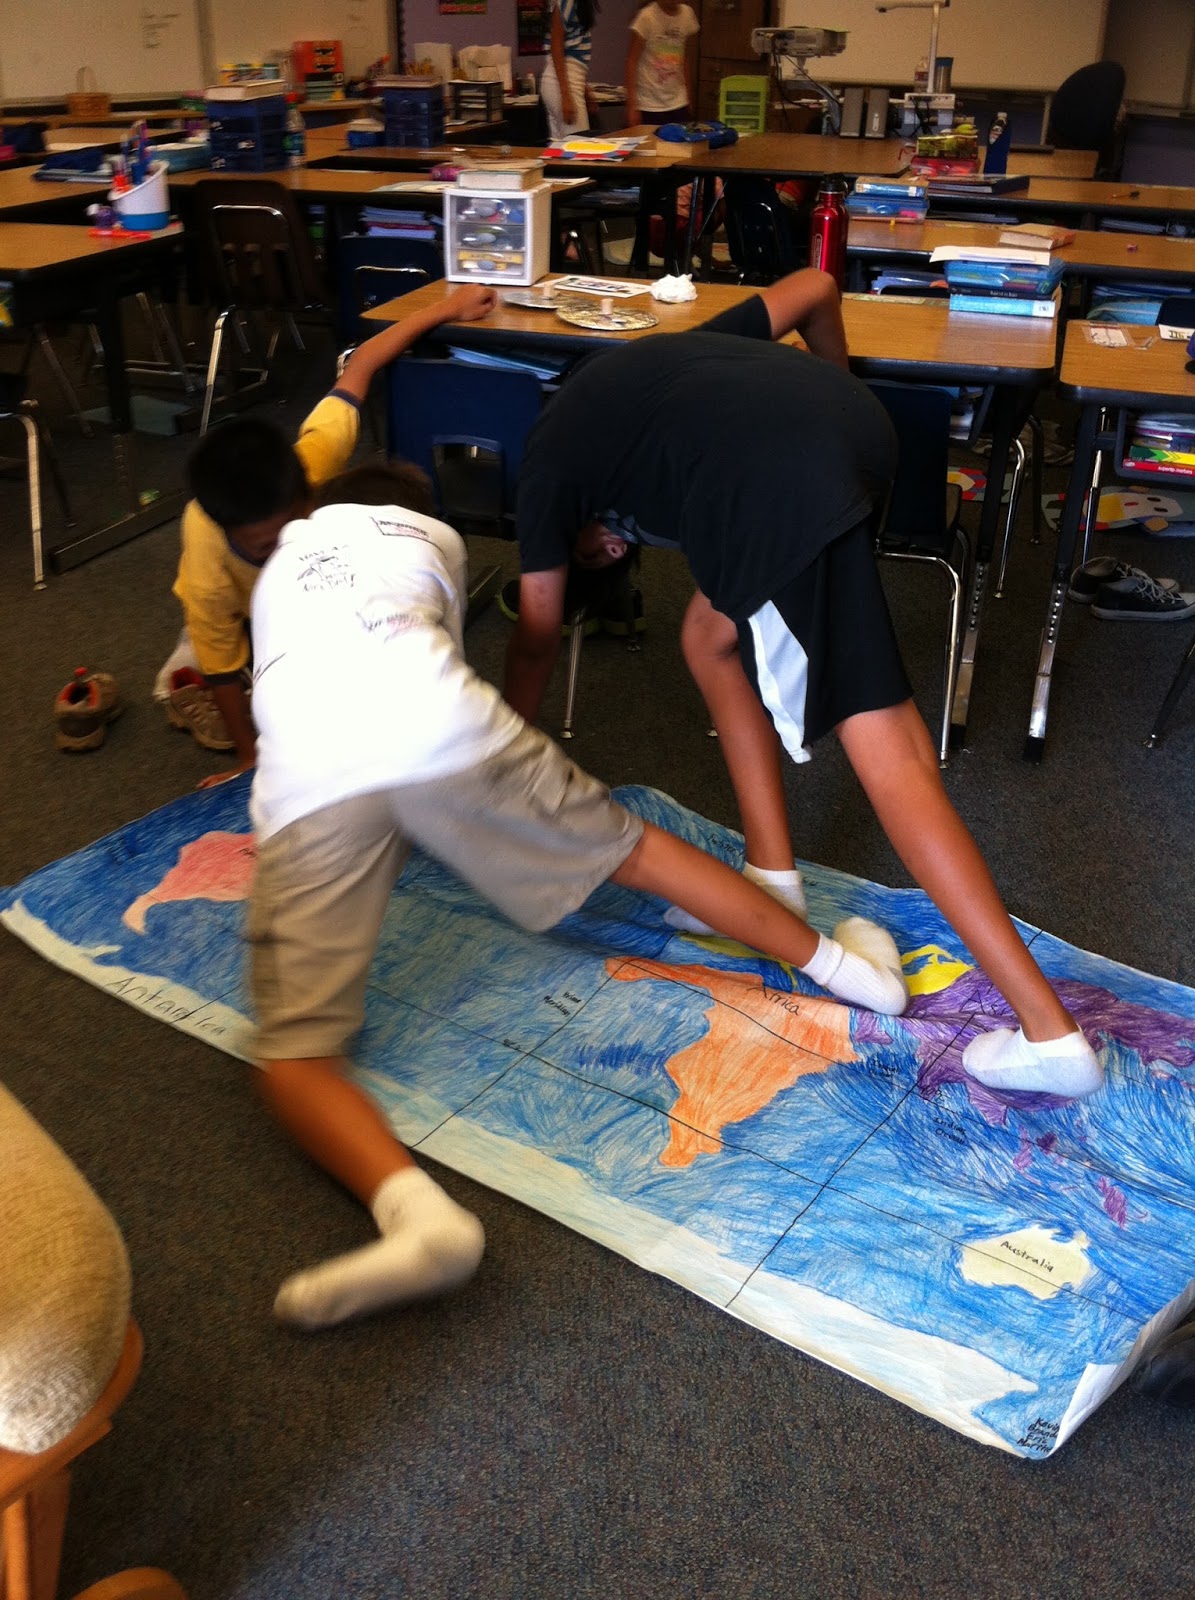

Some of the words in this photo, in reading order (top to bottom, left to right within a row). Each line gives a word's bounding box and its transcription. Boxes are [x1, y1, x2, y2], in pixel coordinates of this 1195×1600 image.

[746, 981, 800, 1016] Africa
[958, 988, 1018, 1018] Asi
[1000, 1240, 1054, 1273] Australia
